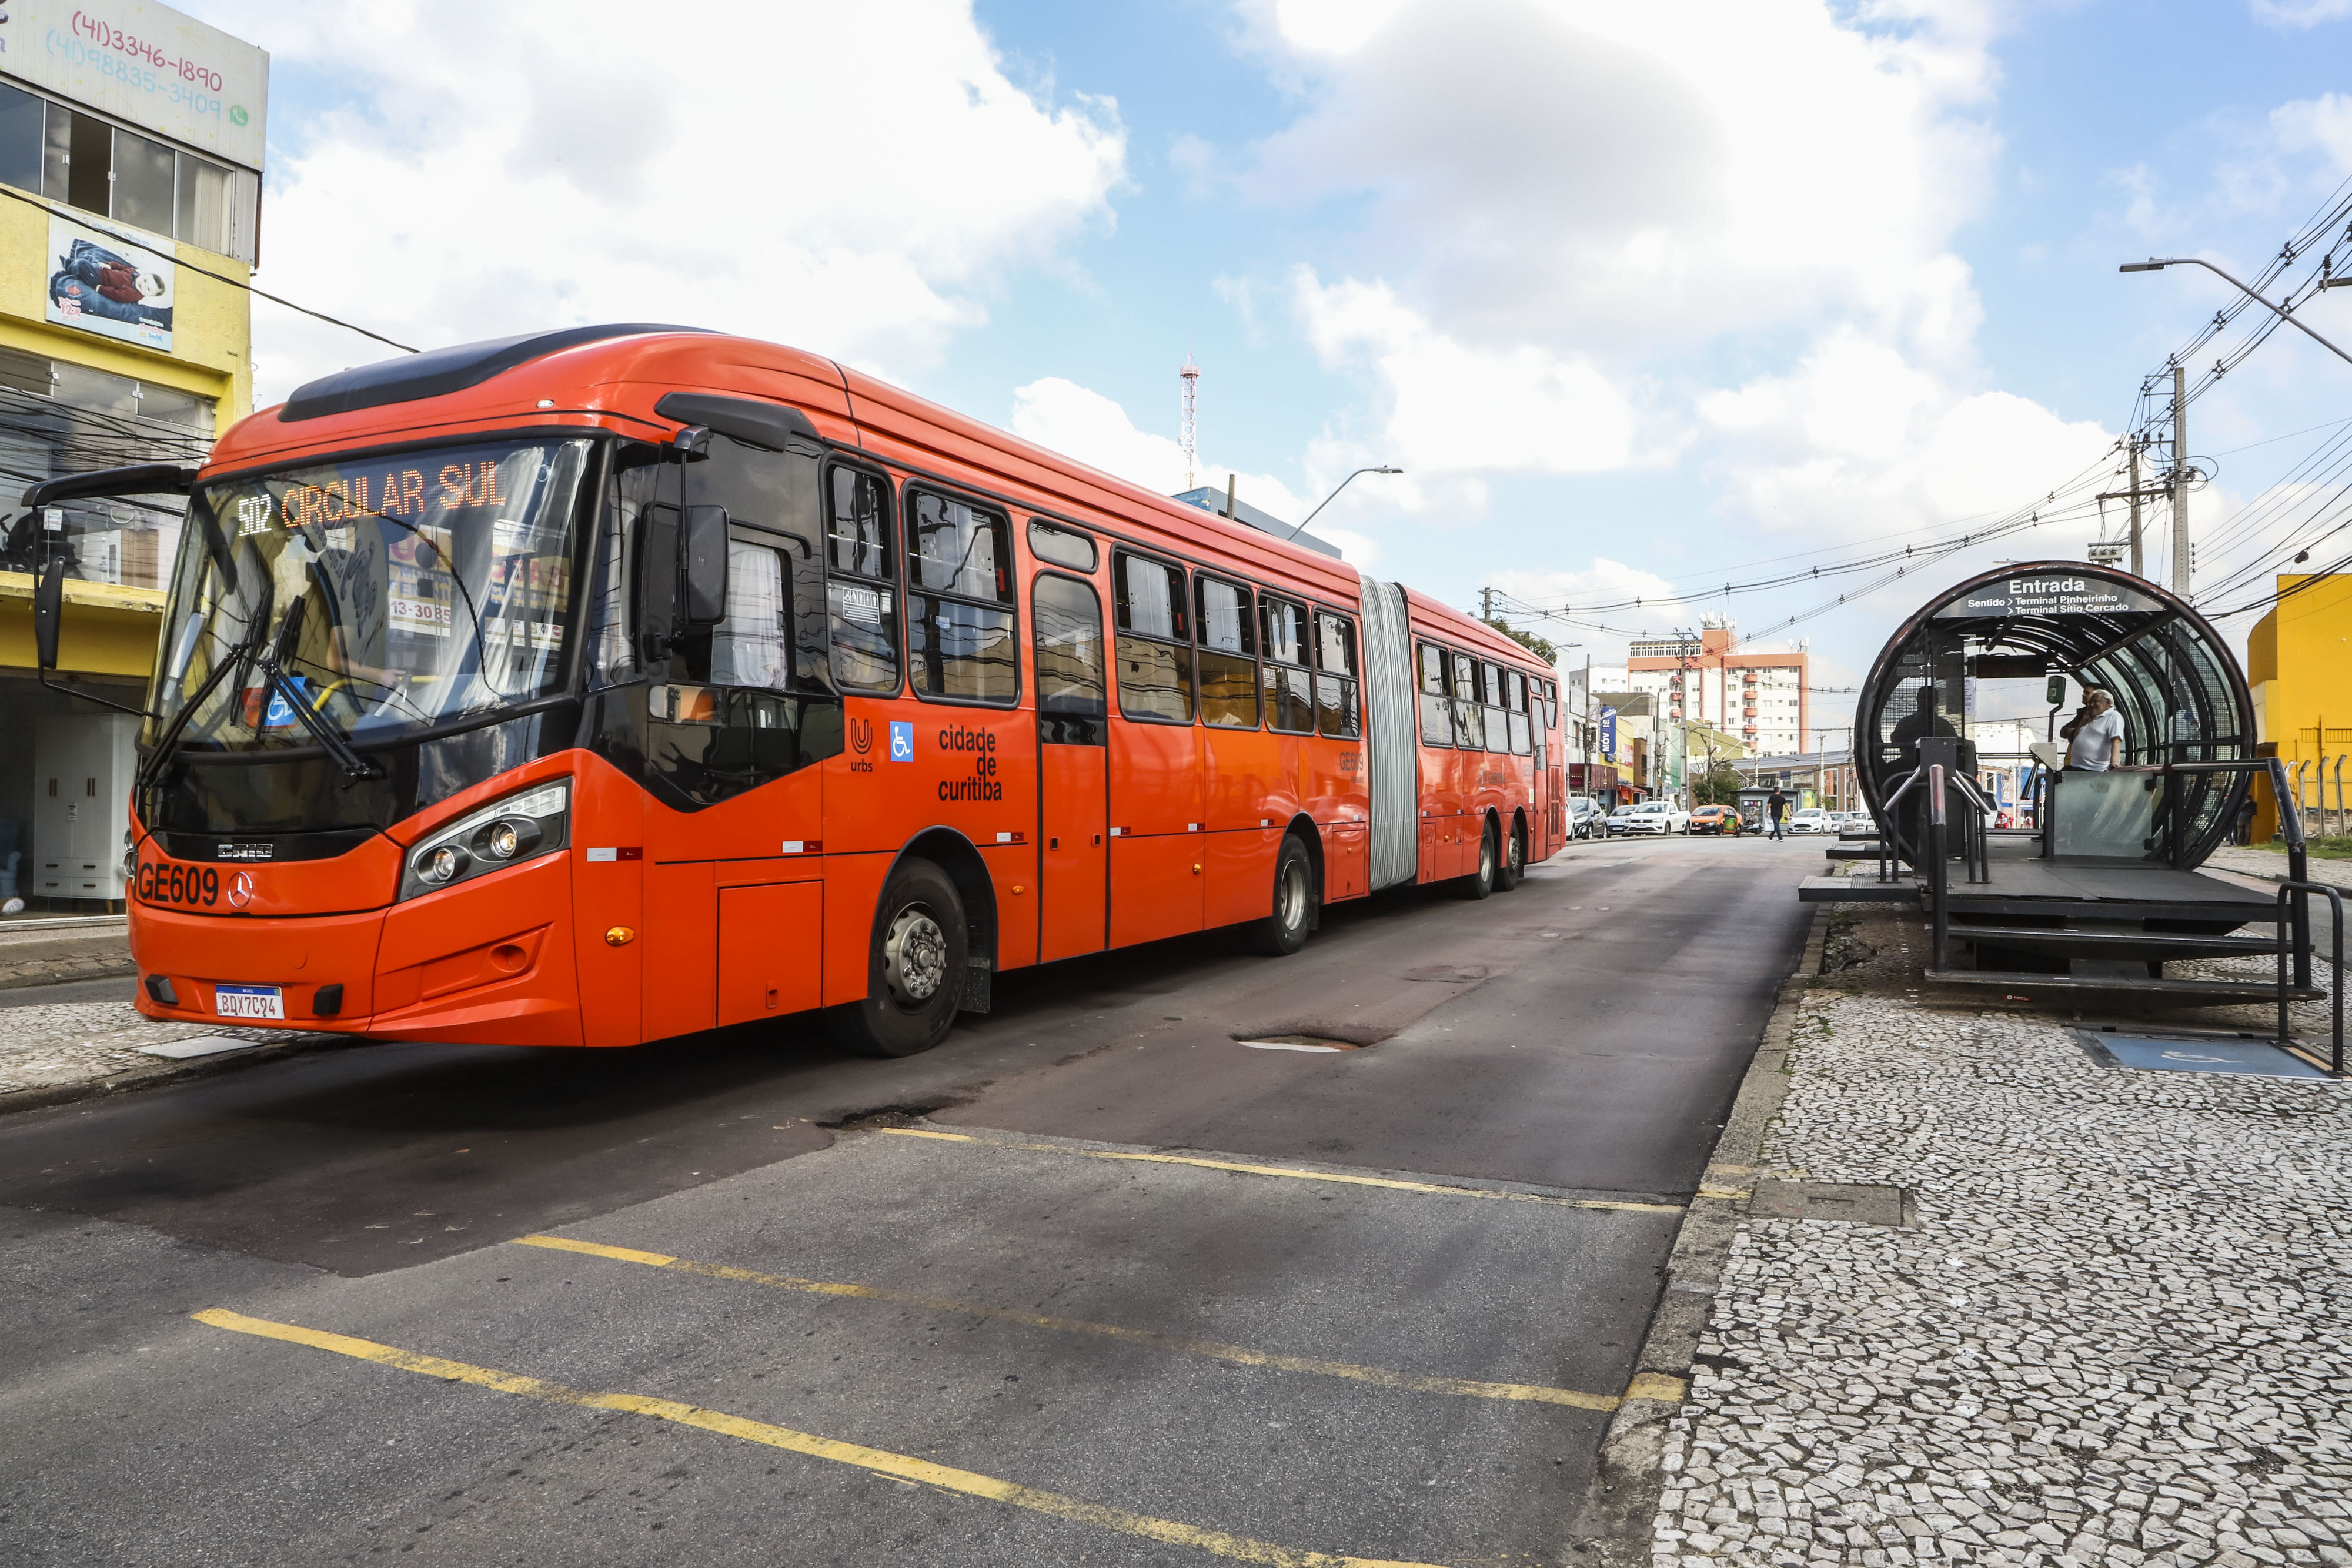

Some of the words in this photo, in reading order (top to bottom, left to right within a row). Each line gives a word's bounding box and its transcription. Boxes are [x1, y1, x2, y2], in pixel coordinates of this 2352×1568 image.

[72, 10, 222, 92] (41)3346-1890
[46, 29, 221, 121] (41)98835-3409
[282, 470, 425, 527] CIRCULAR
[439, 460, 506, 510] SUL
[2009, 578, 2086, 594] Entrada
[1968, 599, 2006, 607] Sentido
[2015, 596, 2057, 606] Terminal
[2060, 594, 2118, 604] Pinheirinho
[2015, 606, 2057, 615] Terminal
[2060, 604, 2083, 613] Sítio
[2085, 603, 2129, 612] Cercado
[939, 724, 996, 753] cidade
[1600, 719, 1610, 752] MÓVIS
[851, 758, 873, 773] urbs
[977, 755, 997, 777] de
[1340, 751, 1364, 771] GE609
[938, 776, 1003, 801] curitiba
[218, 844, 273, 858] CAIO
[139, 862, 219, 906] GE609
[222, 995, 276, 1015] BDX7C94
